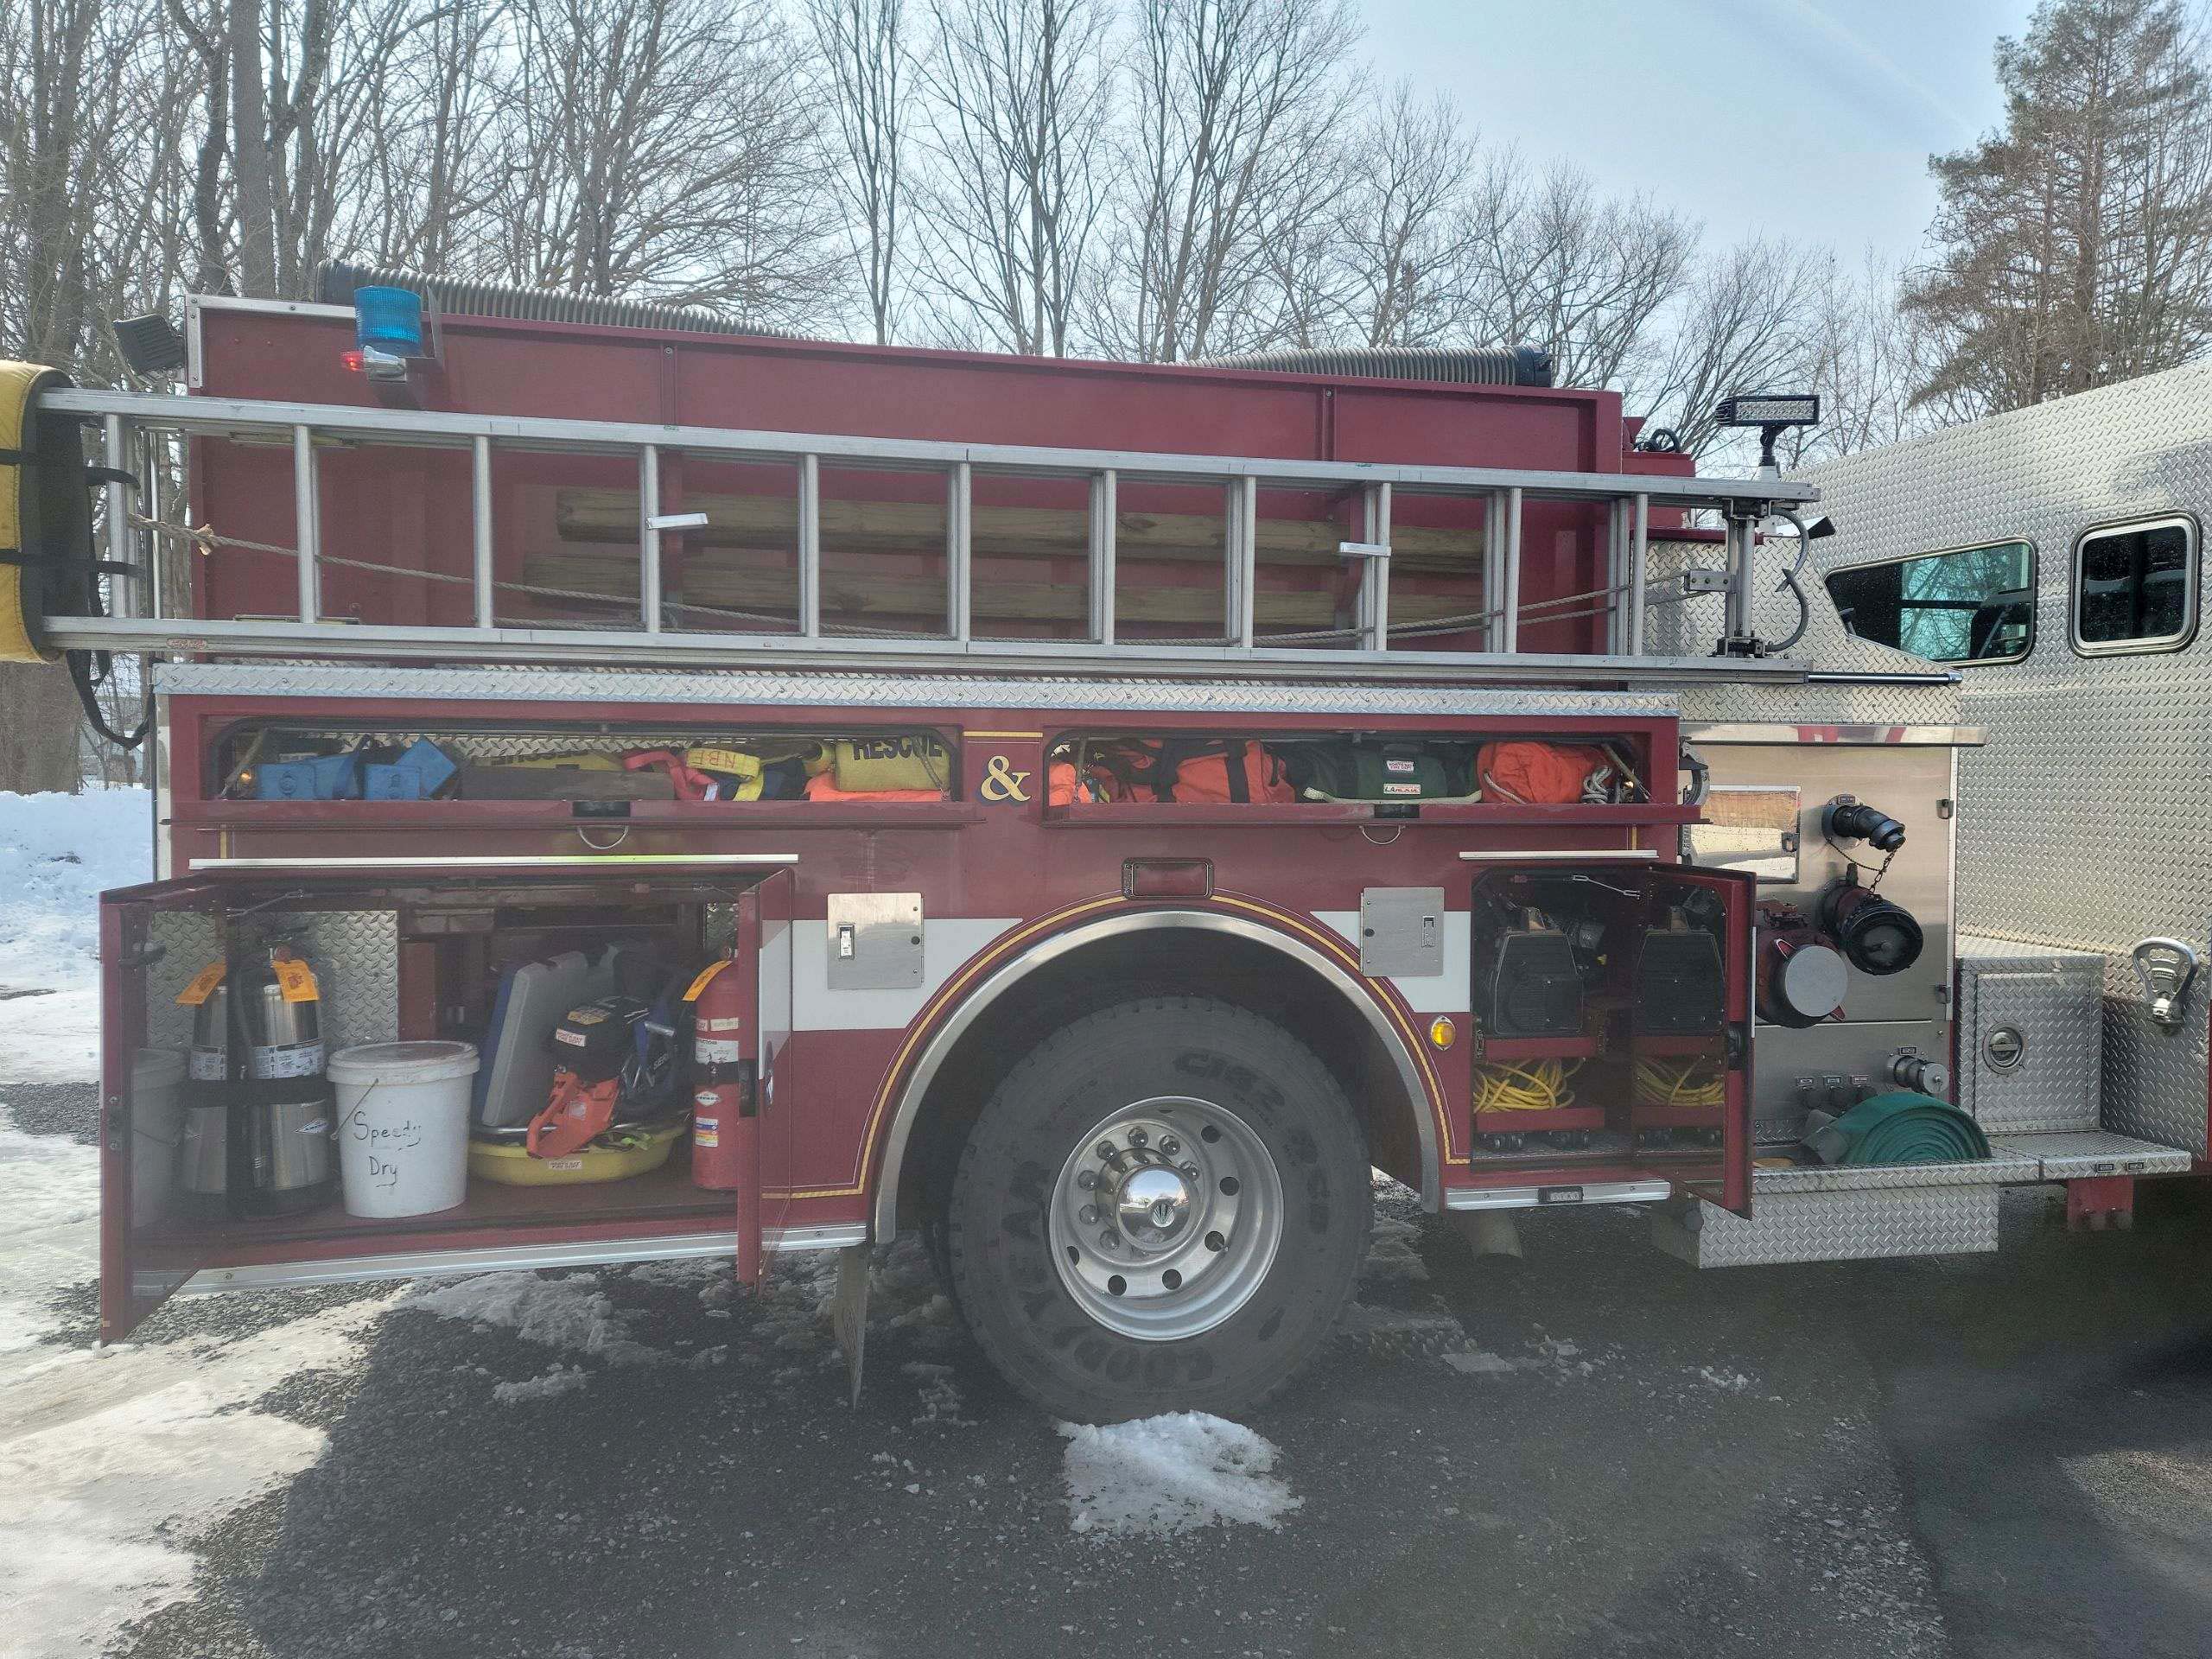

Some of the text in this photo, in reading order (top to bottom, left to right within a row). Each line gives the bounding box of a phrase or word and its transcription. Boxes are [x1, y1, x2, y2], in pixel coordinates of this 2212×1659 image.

[853, 734, 943, 760] RESCUE
[982, 755, 1032, 802] &
[353, 1111, 421, 1152] Speedy
[369, 1155, 397, 1188] Dry
